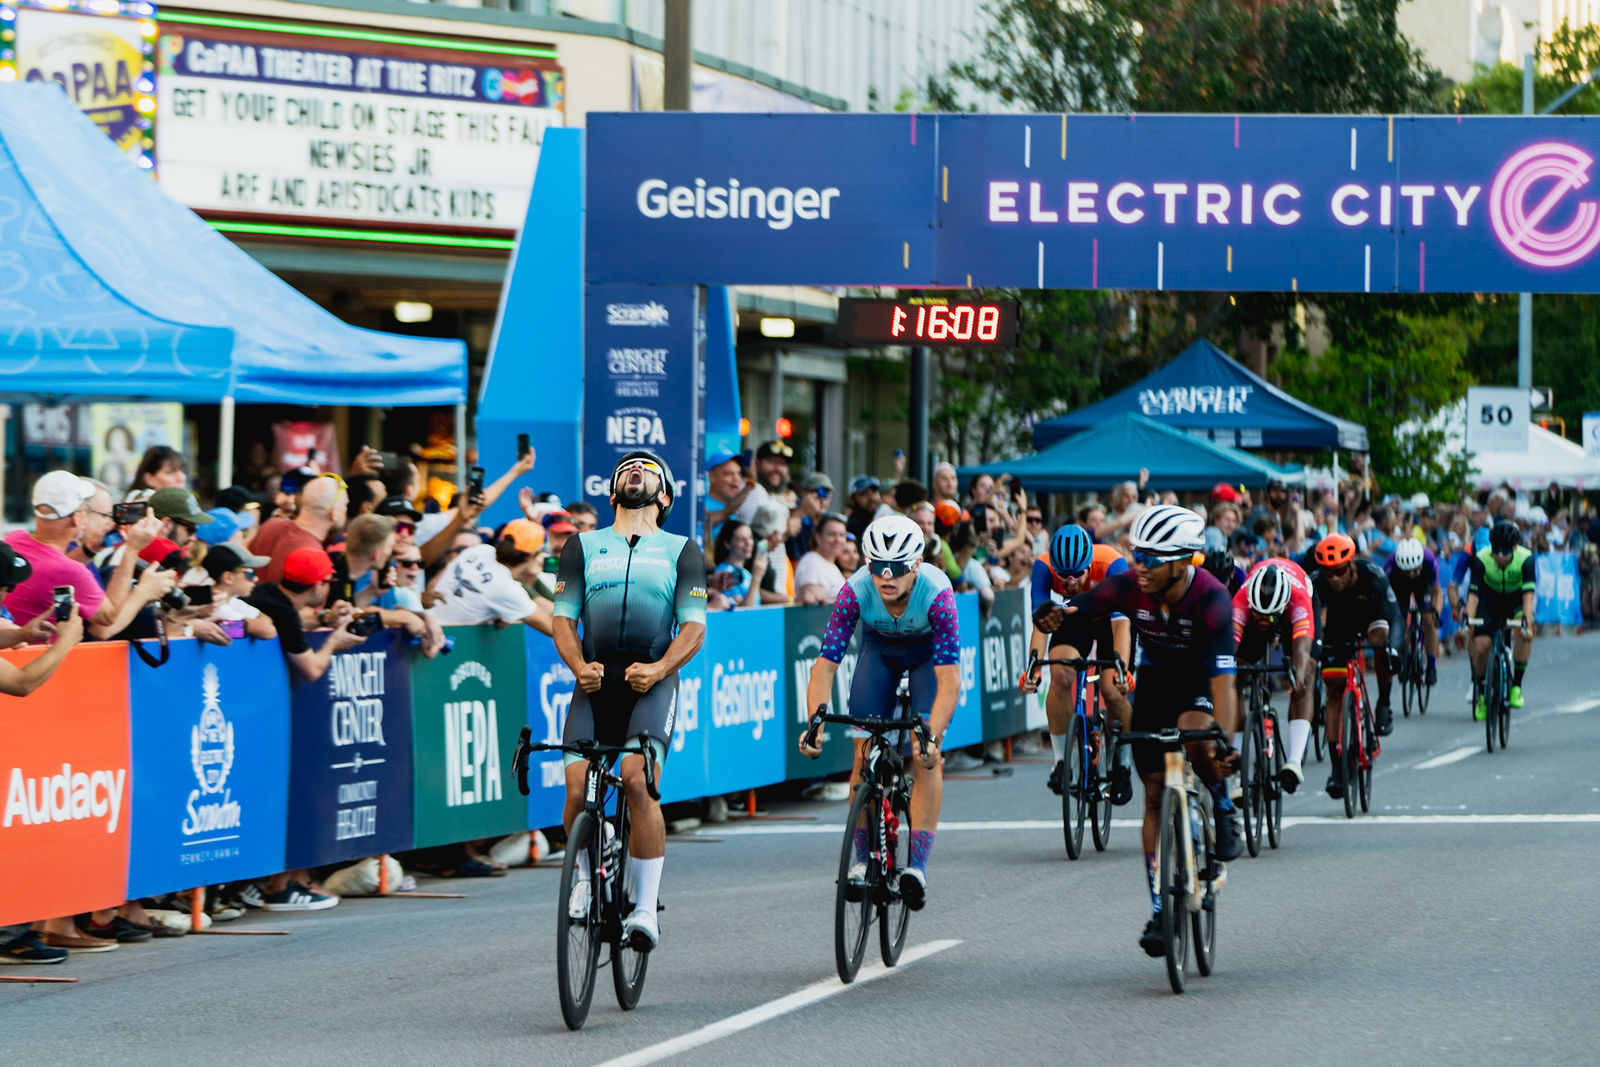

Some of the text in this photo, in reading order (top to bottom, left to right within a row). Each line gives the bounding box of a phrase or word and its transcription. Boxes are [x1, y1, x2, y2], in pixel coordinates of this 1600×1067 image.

[187, 41, 259, 76] CaPAA
[260, 47, 354, 85] THEATER
[355, 57, 385, 88] AT
[386, 60, 428, 93] THE
[429, 64, 476, 98] RITZ
[173, 88, 206, 118] GET
[220, 91, 278, 123] YOUR
[286, 97, 342, 130] CHILD
[351, 103, 376, 131] ON
[387, 107, 445, 139] STAGE
[455, 113, 499, 143] THIS
[309, 139, 432, 176] NEWSIES JR
[270, 177, 306, 208] AND
[316, 180, 441, 218] ARISTOCATS
[449, 190, 495, 220] KIDS
[637, 179, 840, 230] Geisinger
[988, 182, 1482, 226] ELECTRIC CITY
[606, 415, 667, 445] NEPA
[1480, 404, 1513, 425] 50
[331, 651, 387, 697] WRIGHT
[983, 636, 1009, 693] NEPA
[332, 697, 386, 746] CENTER
[711, 658, 778, 740] Geisinger
[444, 699, 502, 807] NEPA
[3, 763, 126, 833] Audacy
